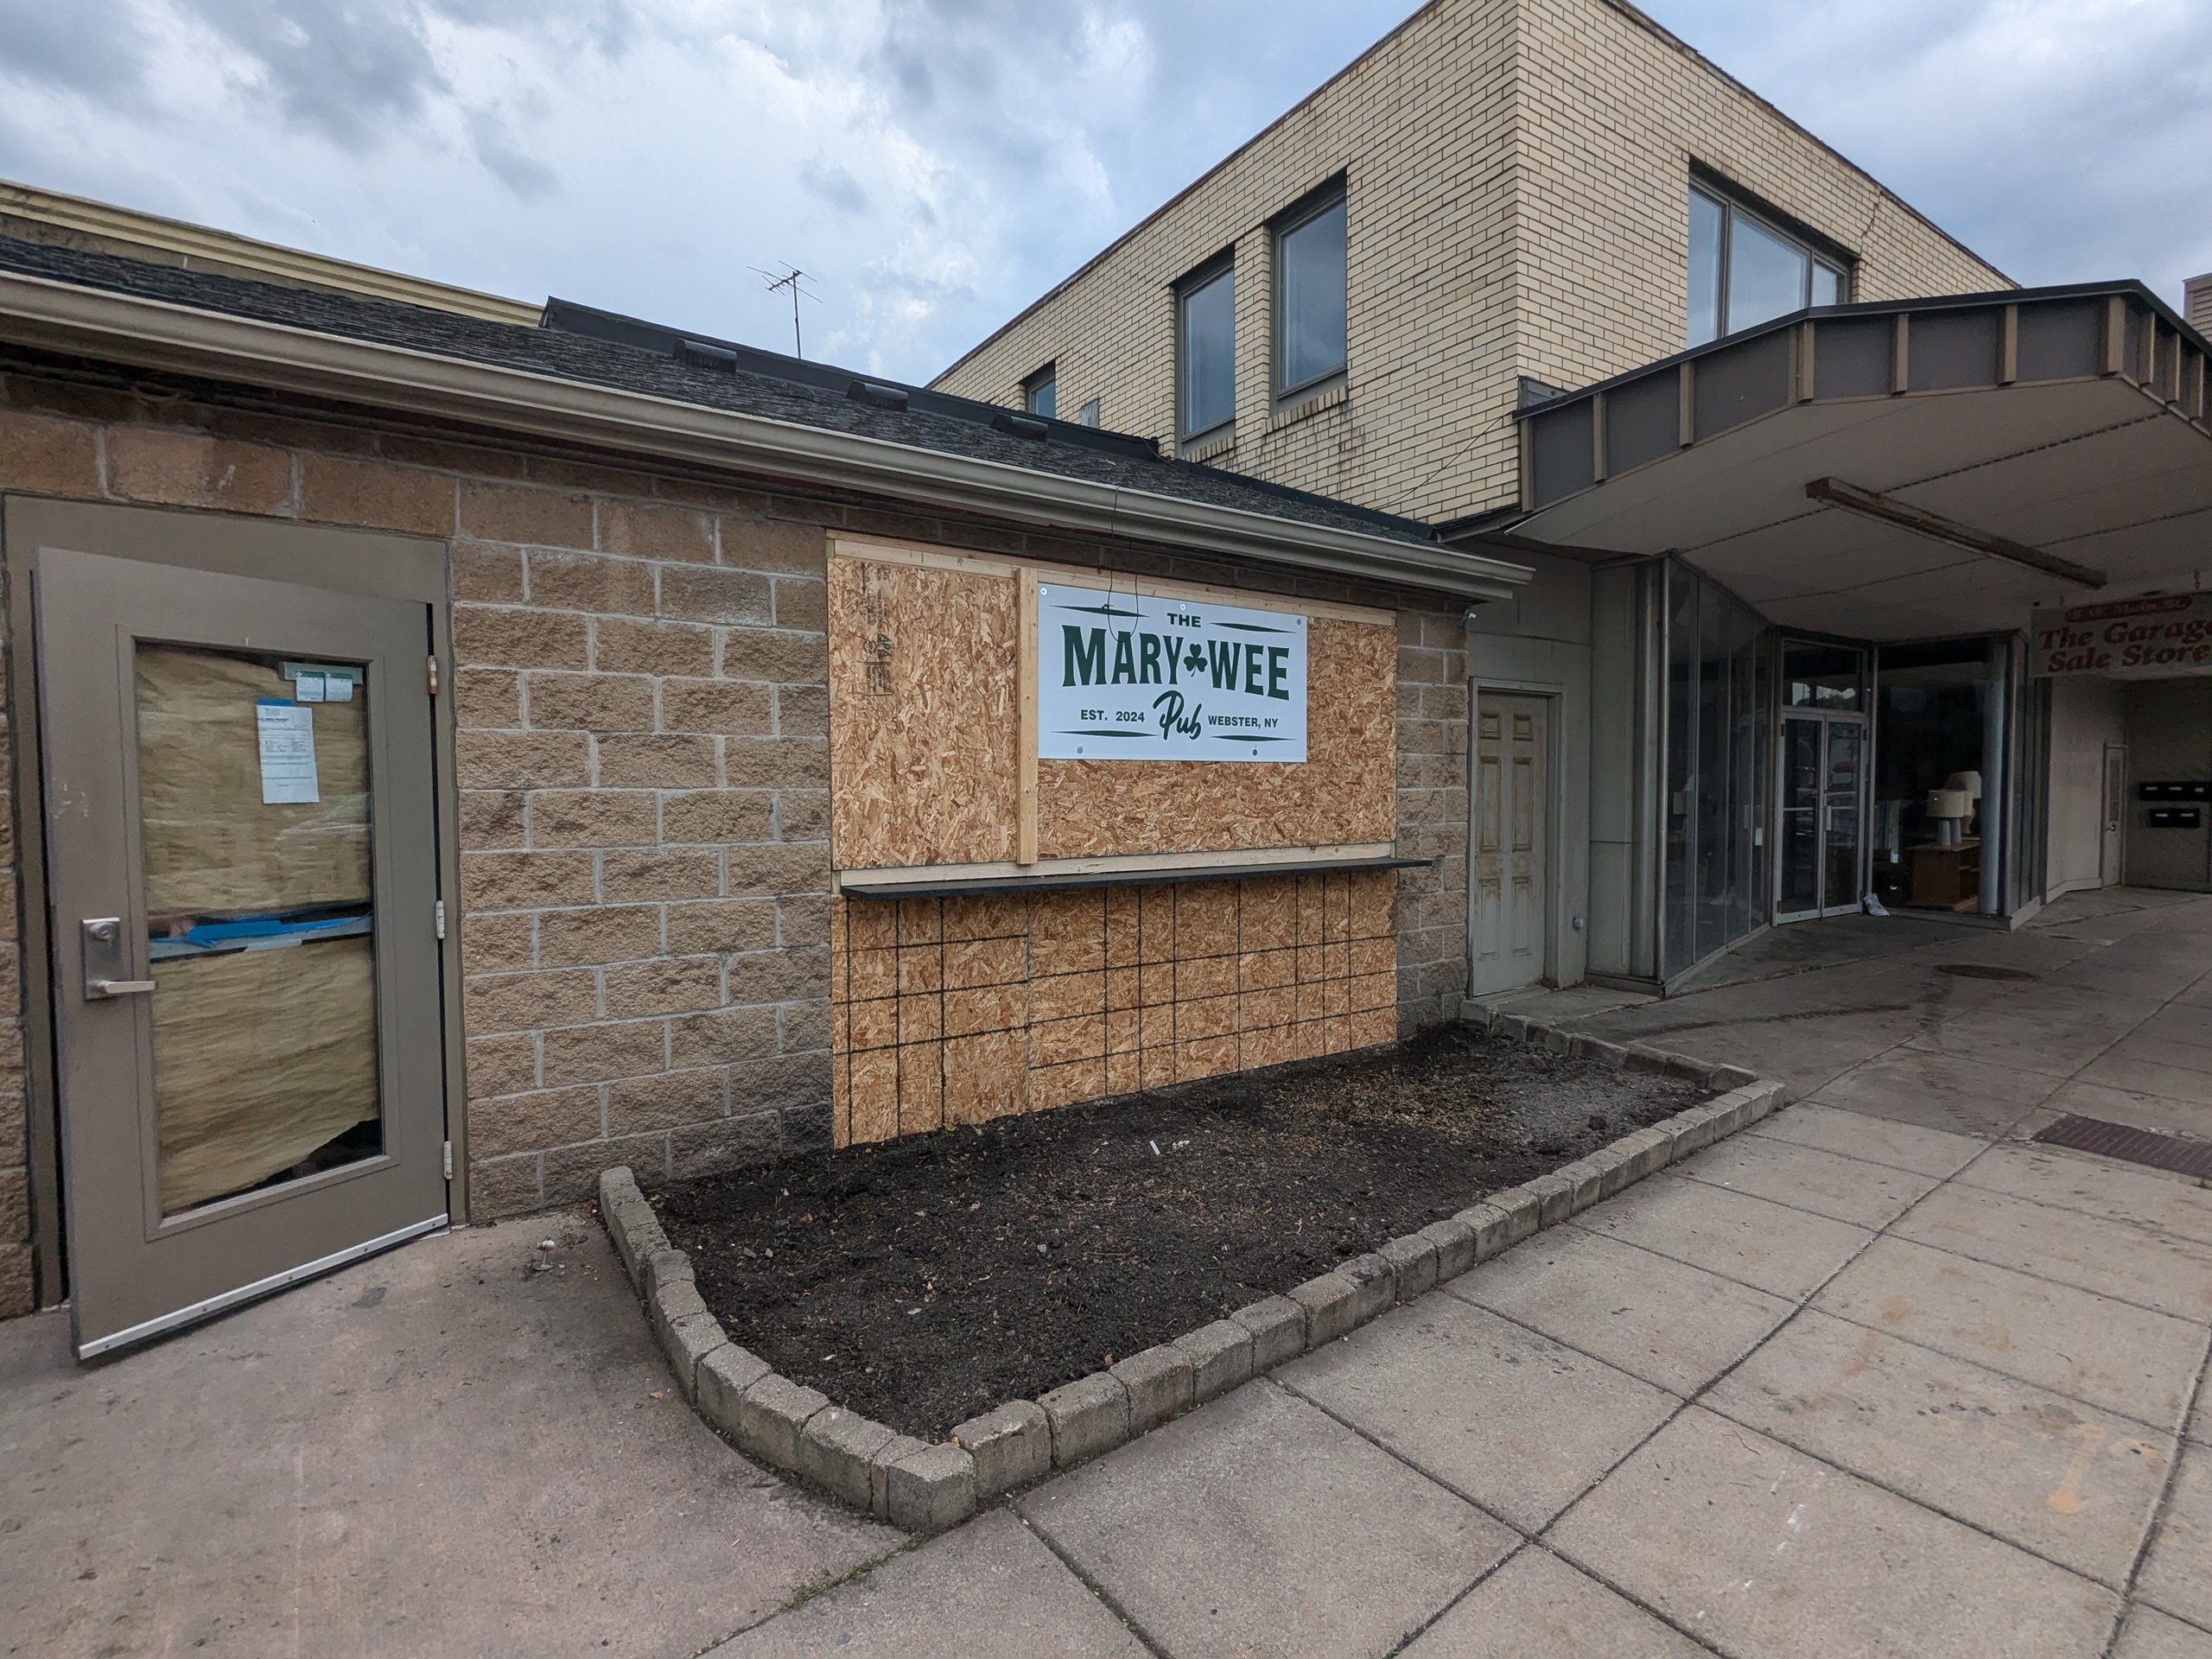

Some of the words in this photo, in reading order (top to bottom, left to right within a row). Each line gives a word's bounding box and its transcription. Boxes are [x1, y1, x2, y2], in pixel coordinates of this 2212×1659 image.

[1166, 613, 1202, 628] THE
[2038, 626, 2094, 650] The
[1061, 624, 1184, 688] MARY
[1207, 639, 1290, 701] WEE
[2047, 646, 2112, 672] Sale
[2121, 644, 2211, 667] Store
[1080, 709, 1108, 721] EST.
[1116, 710, 1146, 722] 2024
[1152, 690, 1202, 741] Pub
[1208, 715, 1262, 729] WEBSTER,
[1264, 717, 1279, 728] NY
